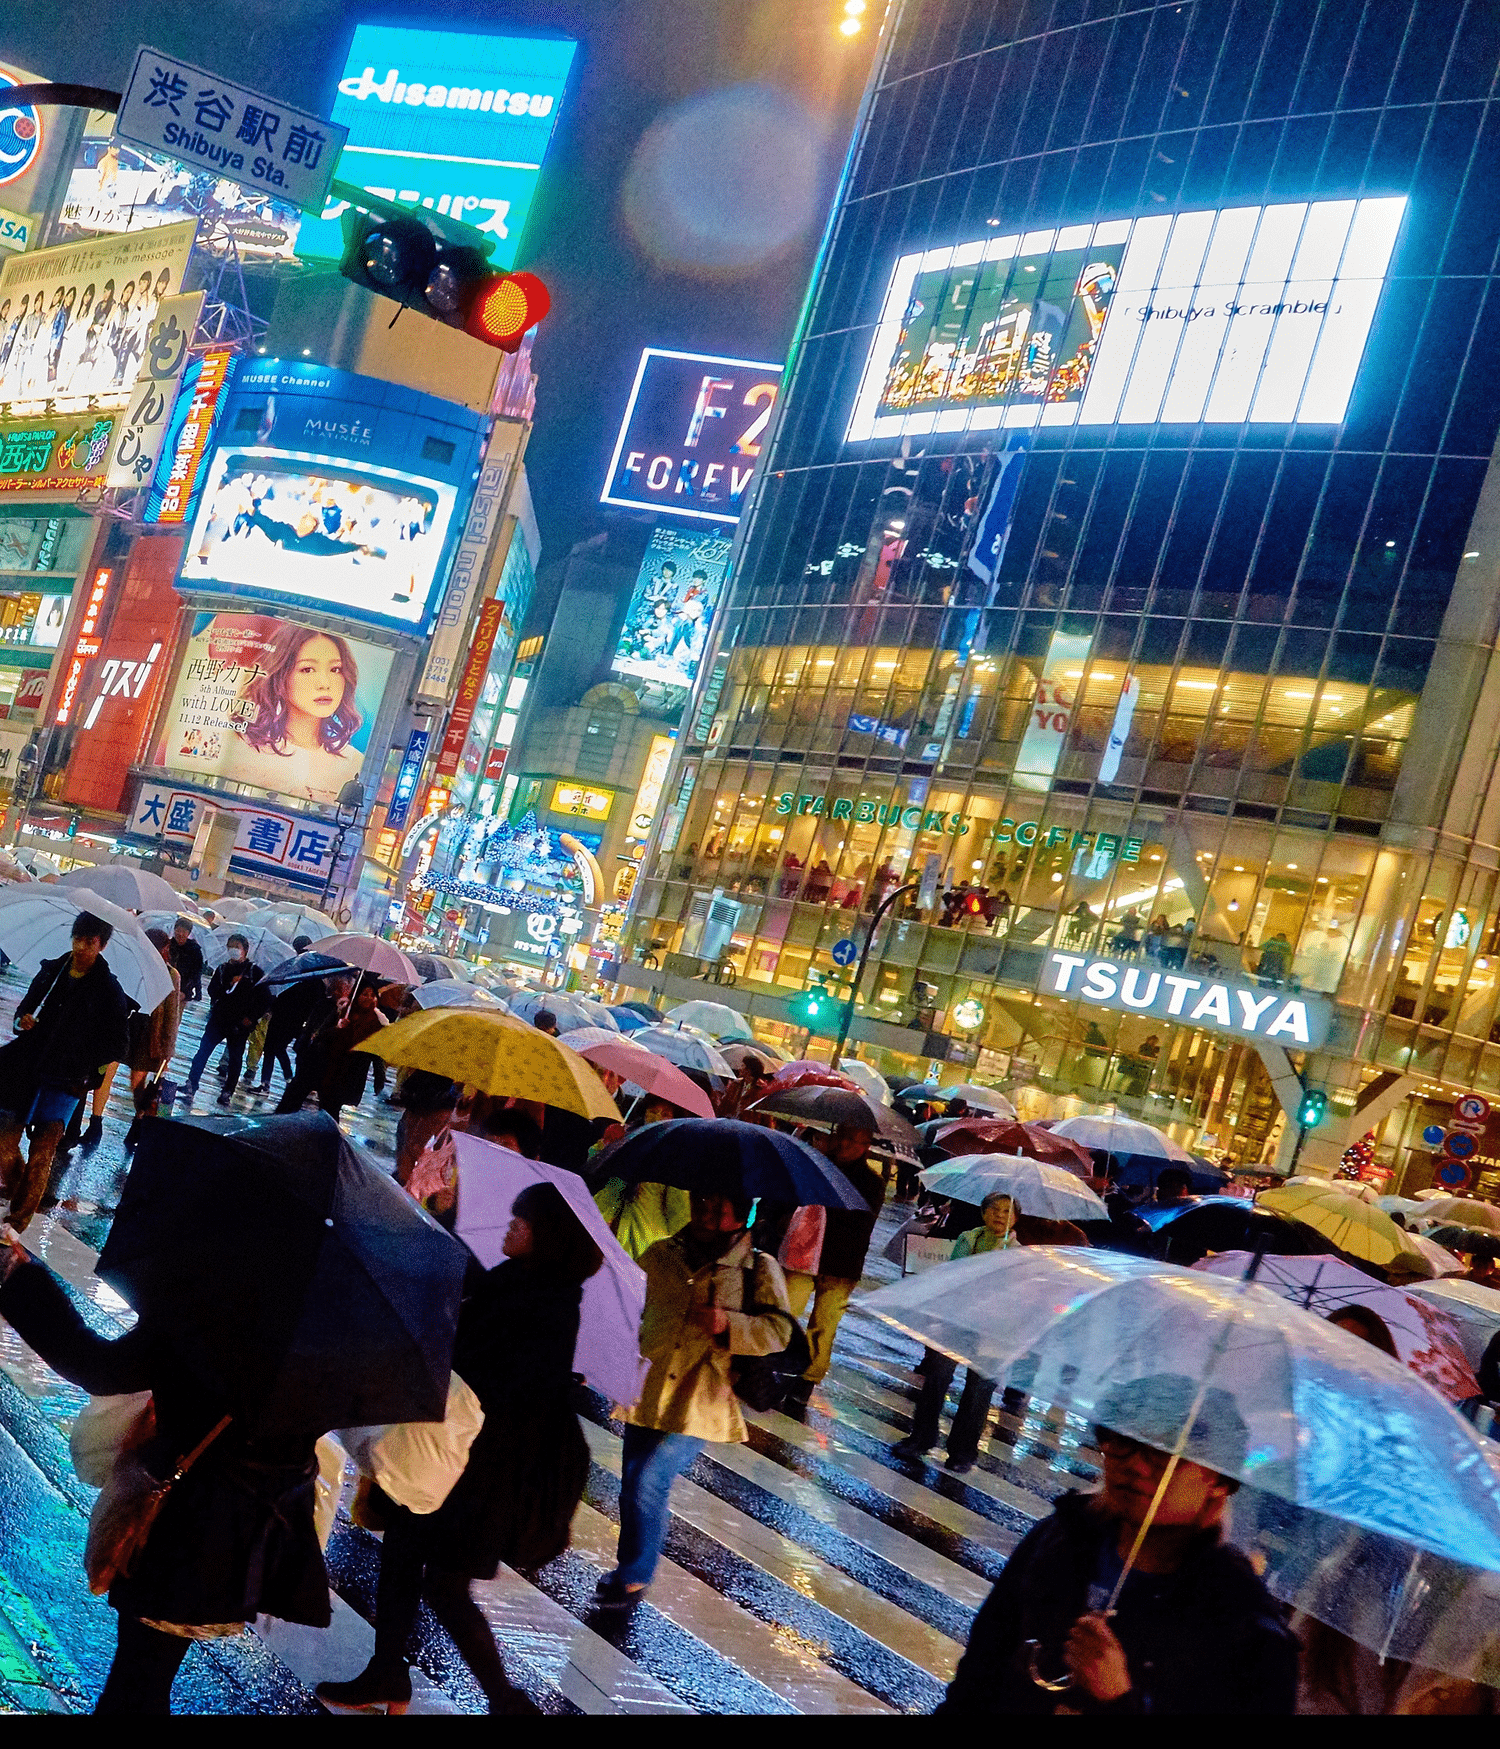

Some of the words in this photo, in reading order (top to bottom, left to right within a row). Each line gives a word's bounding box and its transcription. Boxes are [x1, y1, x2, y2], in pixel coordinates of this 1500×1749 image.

[143, 66, 327, 170] 渋谷駅前
[338, 68, 555, 118] Hisamitsu
[163, 122, 245, 170] Shibuya
[251, 156, 290, 190] Sta.
[116, 314, 187, 482] もんじゃ
[242, 374, 278, 384] MUSEE
[281, 375, 331, 388] Channel
[161, 359, 220, 512] 三千里薬品
[186, 657, 267, 686] 西野カナ
[463, 603, 500, 699] クスリのことなら
[178, 713, 202, 726] 11.12
[203, 716, 249, 733] Release!
[182, 694, 208, 711] with
[210, 696, 256, 719] LOVE
[199, 684, 212, 694] 5th
[212, 685, 237, 697] Album
[439, 706, 472, 768] 三千里
[776, 792, 971, 837] STARBUCKS
[990, 818, 1144, 863] COFFEE
[1051, 953, 1311, 1044] TSUTAYA
